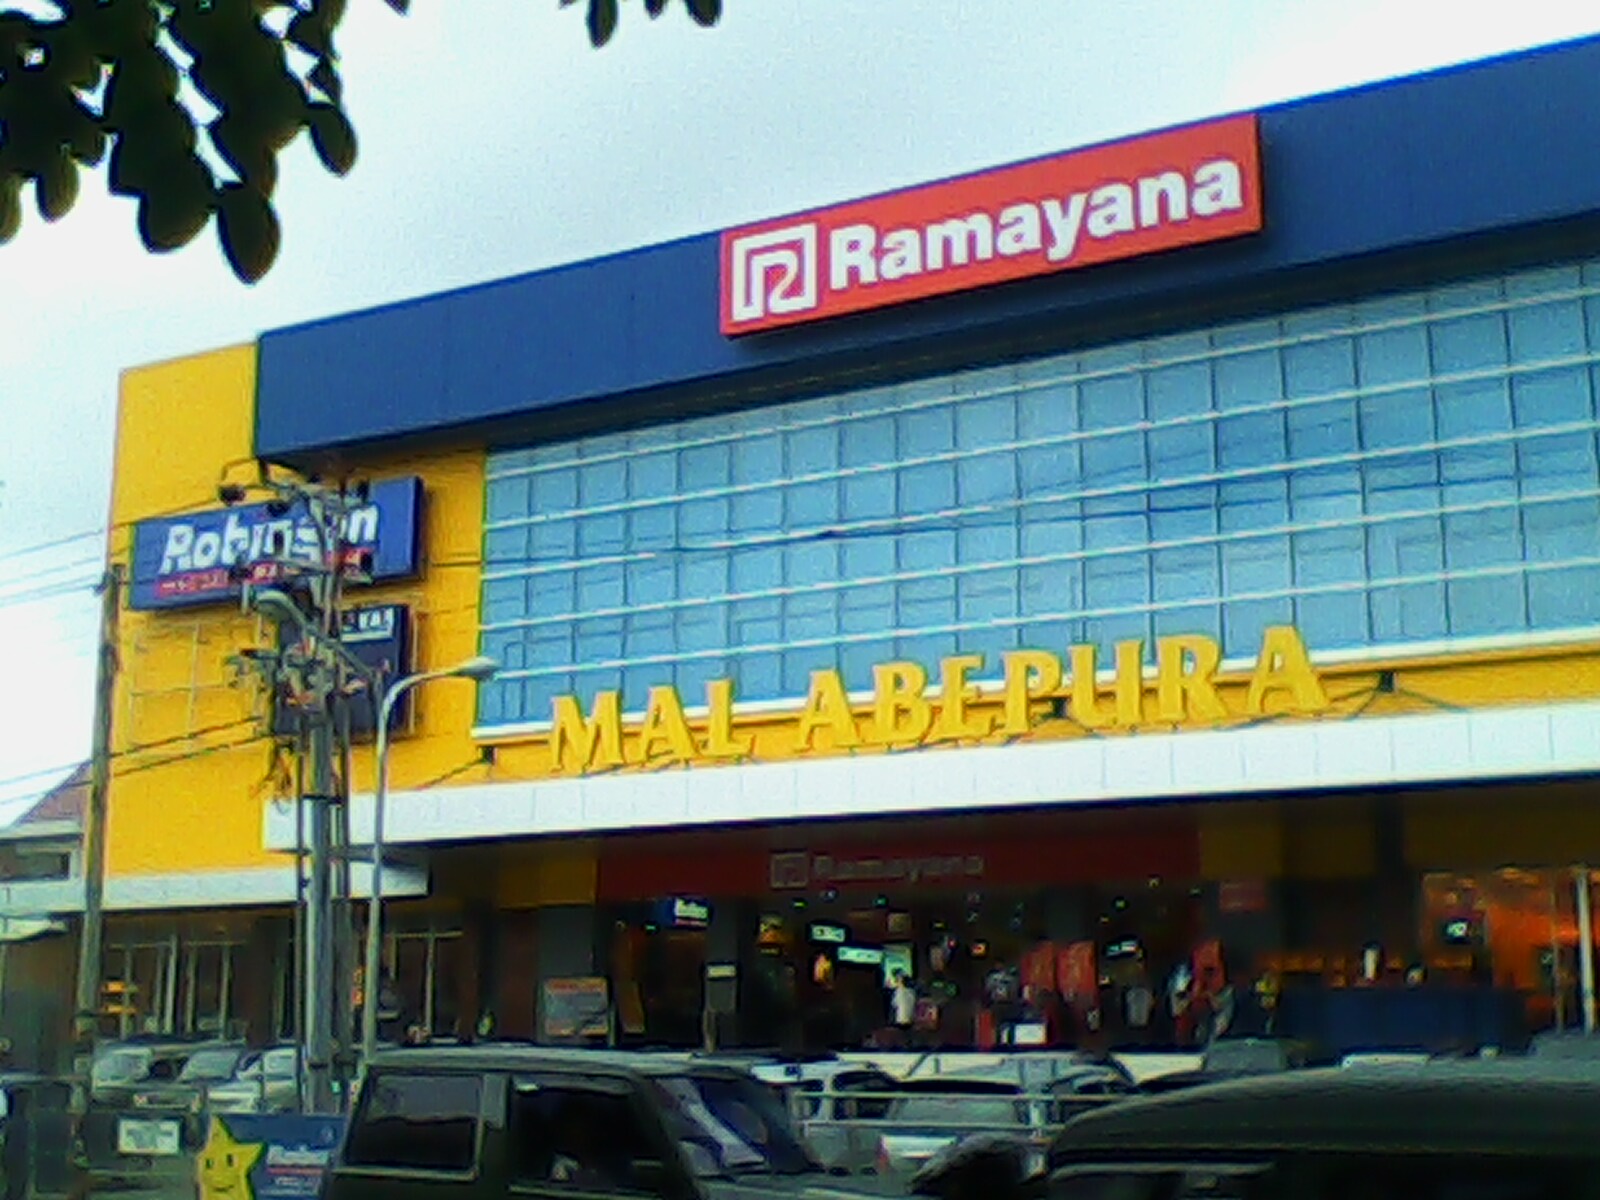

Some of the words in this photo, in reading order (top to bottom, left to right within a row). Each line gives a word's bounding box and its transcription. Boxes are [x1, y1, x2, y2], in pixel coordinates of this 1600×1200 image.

[829, 159, 1243, 290] Ramayana
[549, 679, 755, 773] MAL
[795, 626, 1330, 752] ABEPURA
